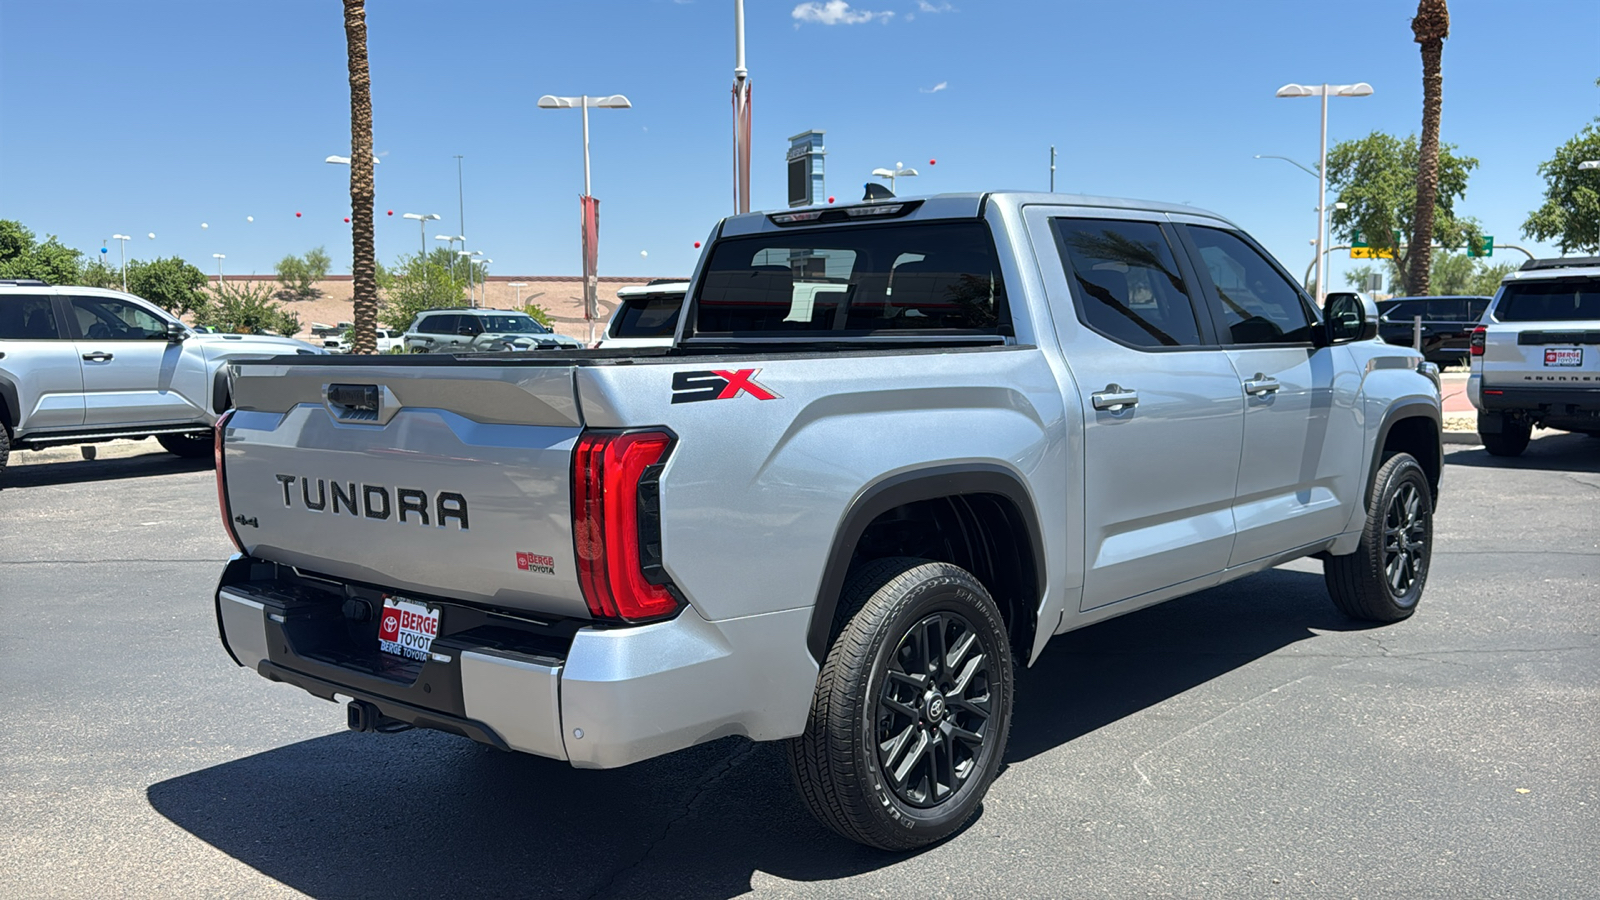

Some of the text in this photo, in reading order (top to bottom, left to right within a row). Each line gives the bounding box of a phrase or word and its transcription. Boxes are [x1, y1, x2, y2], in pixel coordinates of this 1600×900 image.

[671, 368, 784, 404] SX
[275, 474, 469, 531] TUNDRA
[527, 551, 554, 567] BERGE
[528, 564, 555, 575] TOYOTA
[401, 610, 438, 636] BERGE
[381, 641, 428, 662] BERGE TOYOTA
[400, 632, 431, 651] TOYOT
